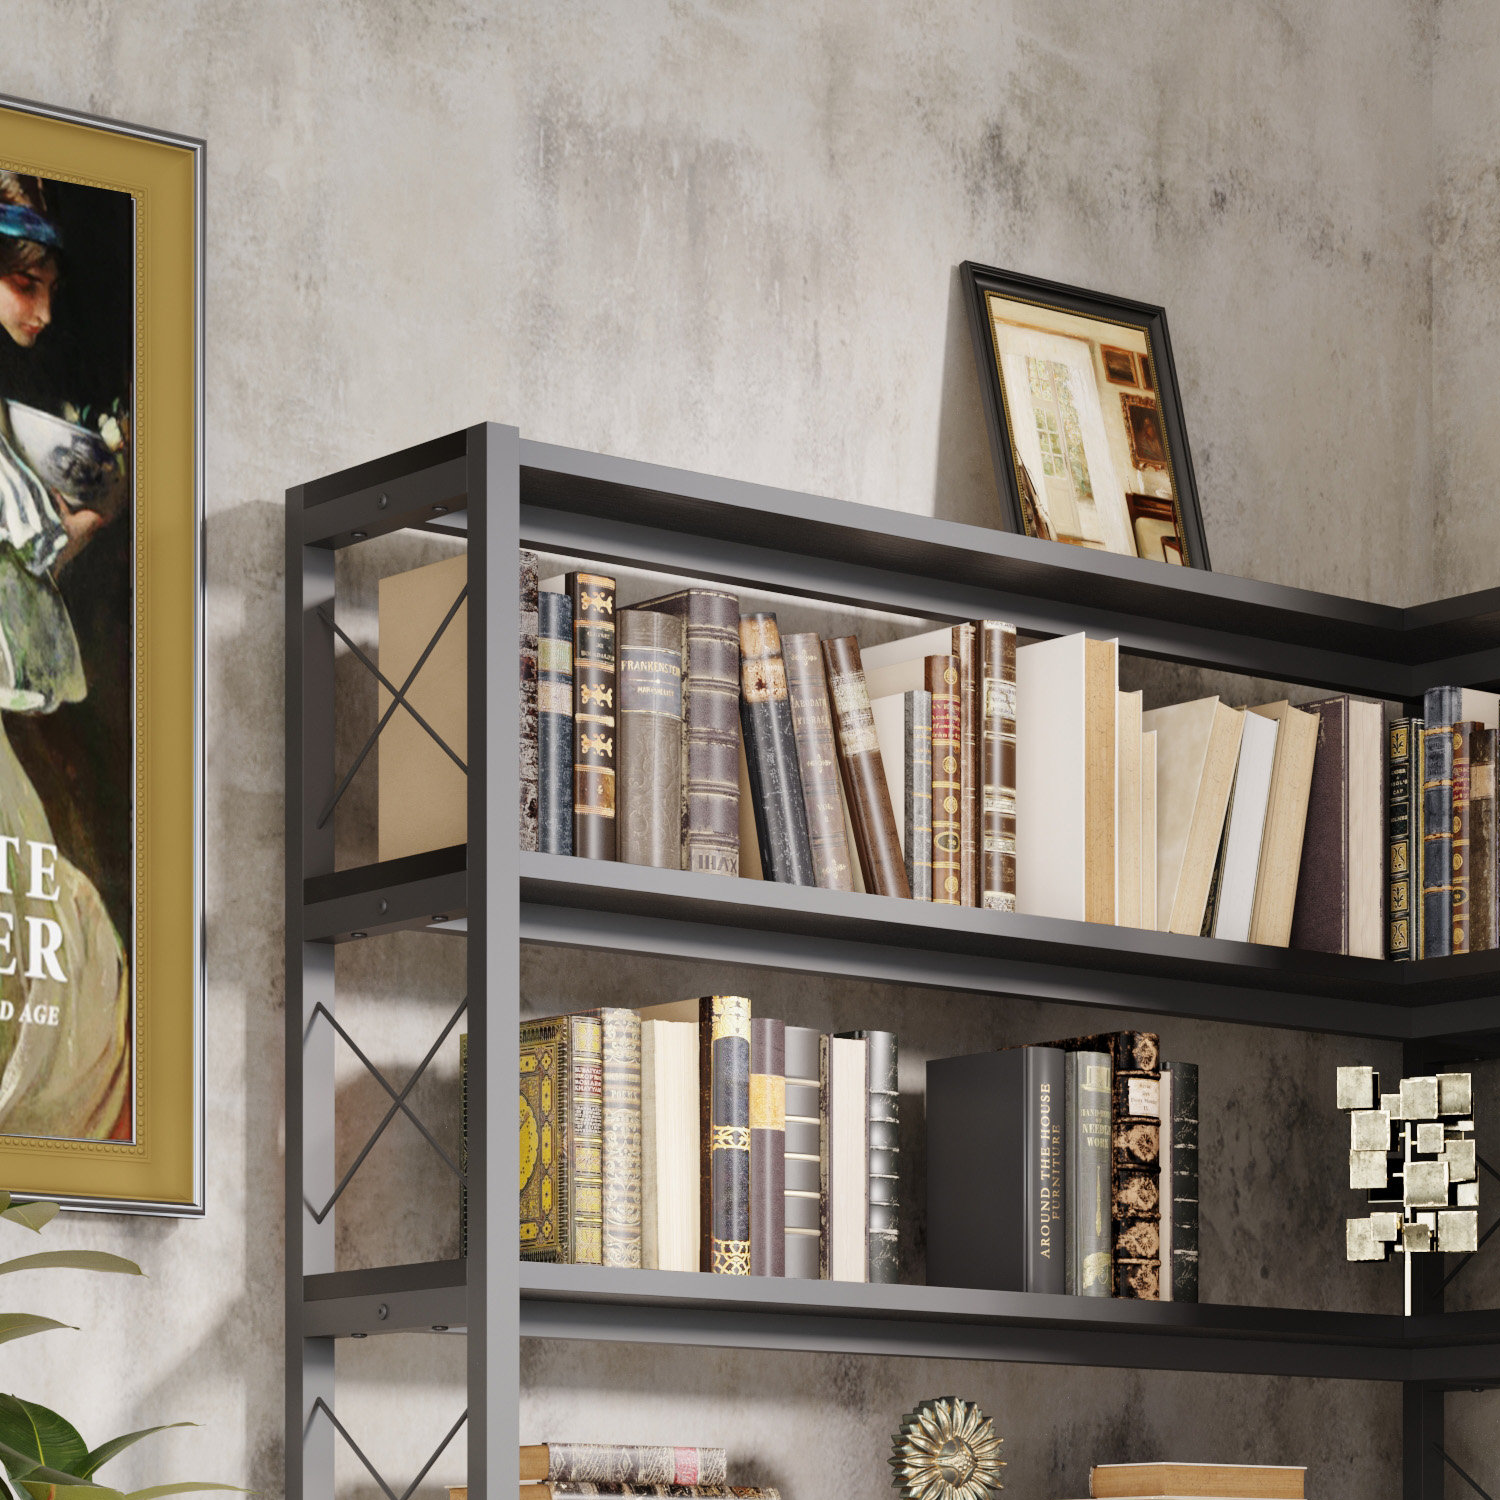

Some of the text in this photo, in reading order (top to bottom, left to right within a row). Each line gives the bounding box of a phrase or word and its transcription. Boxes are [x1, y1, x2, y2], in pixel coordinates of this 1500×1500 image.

[18, 1003, 60, 1027] AGE
[1040, 1082, 1051, 1260] AROUND THE HOUSE
[1052, 1124, 1061, 1220] FURNITURE
